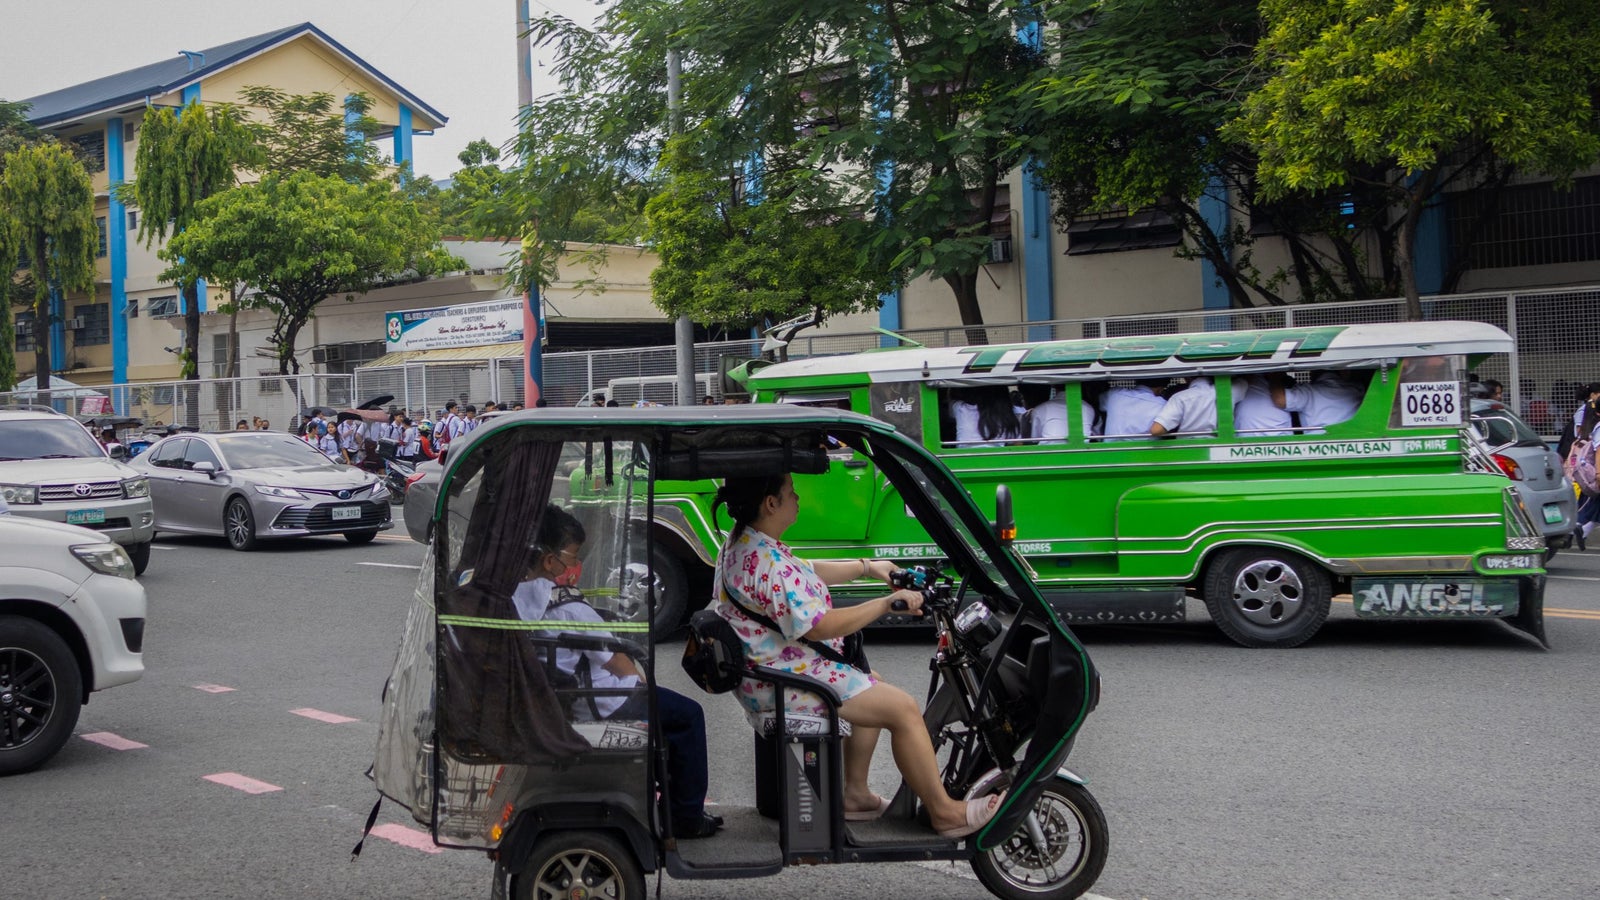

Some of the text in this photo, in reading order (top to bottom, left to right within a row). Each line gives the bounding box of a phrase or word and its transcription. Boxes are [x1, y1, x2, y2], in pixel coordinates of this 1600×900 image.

[1407, 393, 1454, 414] 0688
[1230, 441, 1392, 457] MARIKINA MONTALBAN
[1405, 439, 1447, 451] FOR HIRE
[902, 546, 923, 556] CASE
[1358, 583, 1504, 612] ANGEL
